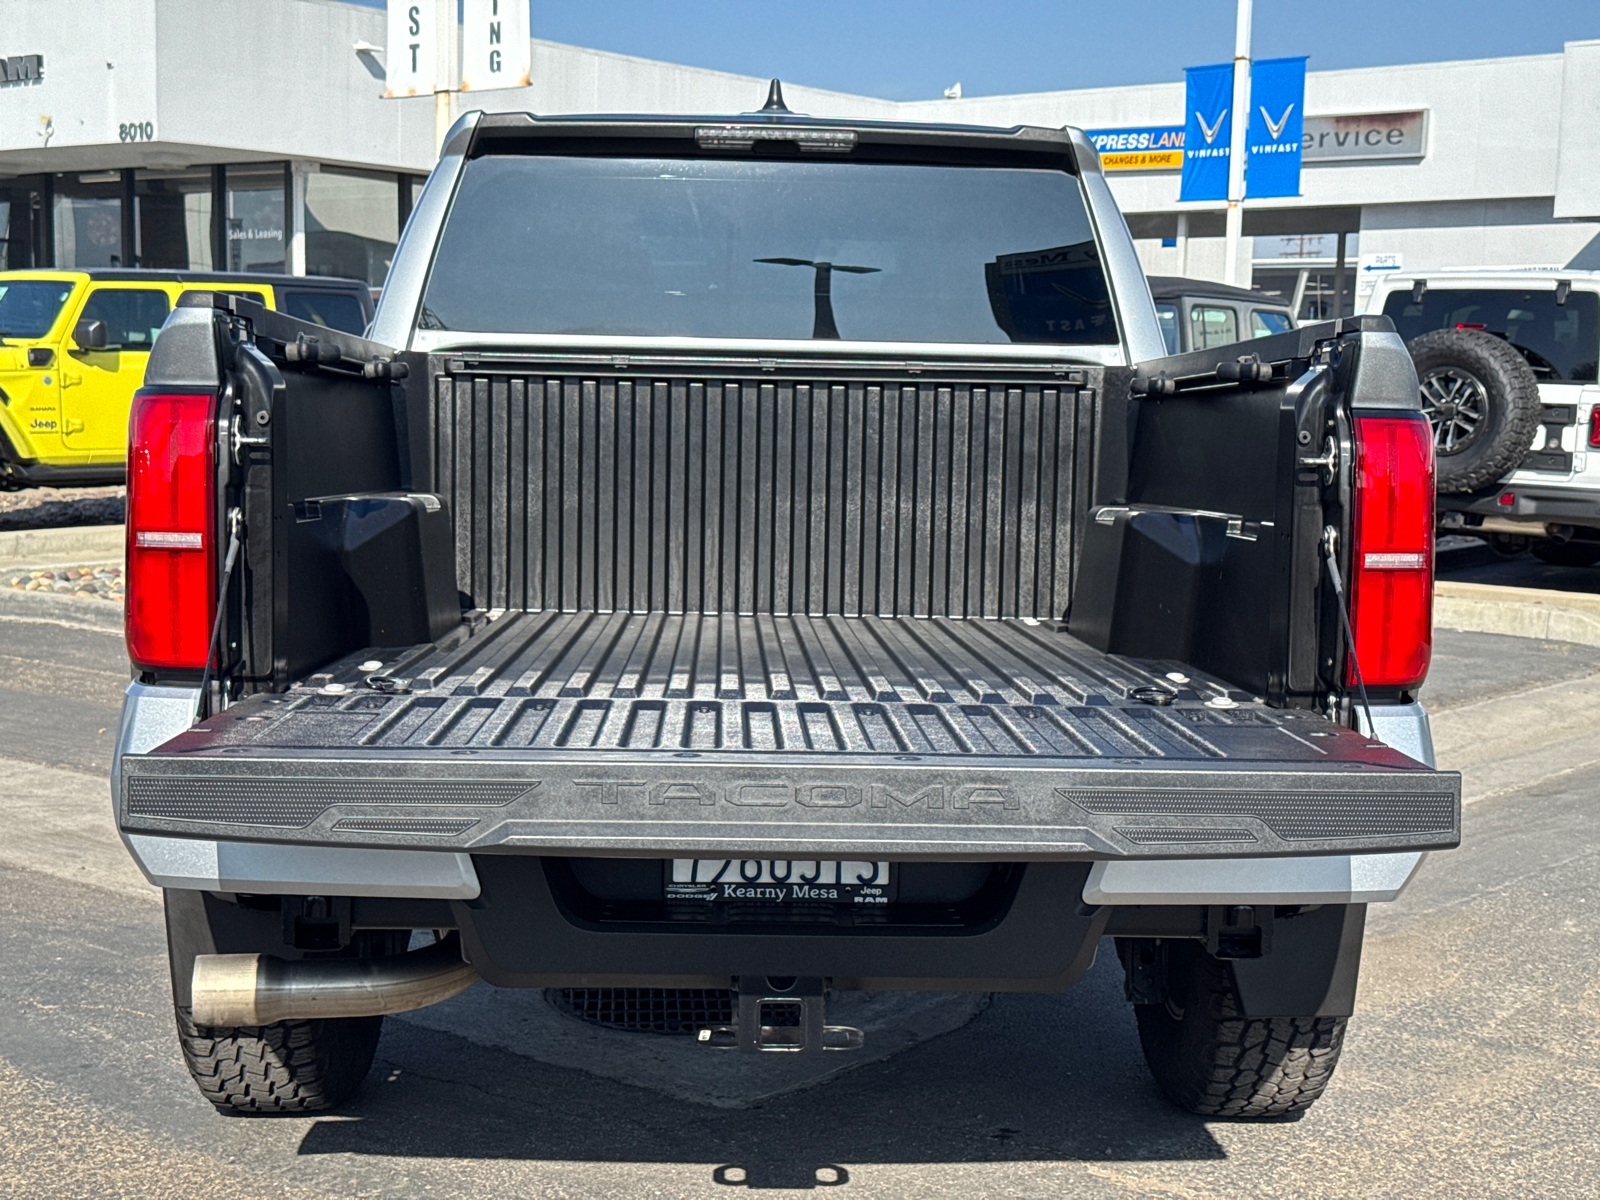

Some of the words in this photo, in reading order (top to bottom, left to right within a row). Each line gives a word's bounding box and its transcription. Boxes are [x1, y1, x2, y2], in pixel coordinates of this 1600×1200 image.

[0, 55, 39, 81] M
[119, 121, 154, 143] 8010
[1302, 125, 1404, 150] ervice
[1187, 147, 1230, 159] VINFAST
[1251, 142, 1299, 155] VINFAST
[1103, 155, 1139, 166] CHANGES
[1140, 154, 1147, 164] &
[1148, 153, 1172, 164] MORE
[228, 229, 246, 240] Sales
[248, 228, 253, 239] &
[255, 227, 282, 241] Leasing
[30, 418, 57, 430] Jeep
[572, 780, 1021, 811] TACOMA
[723, 884, 787, 902] Kearny
[791, 885, 839, 899] Mesa
[859, 886, 883, 896] Jeep
